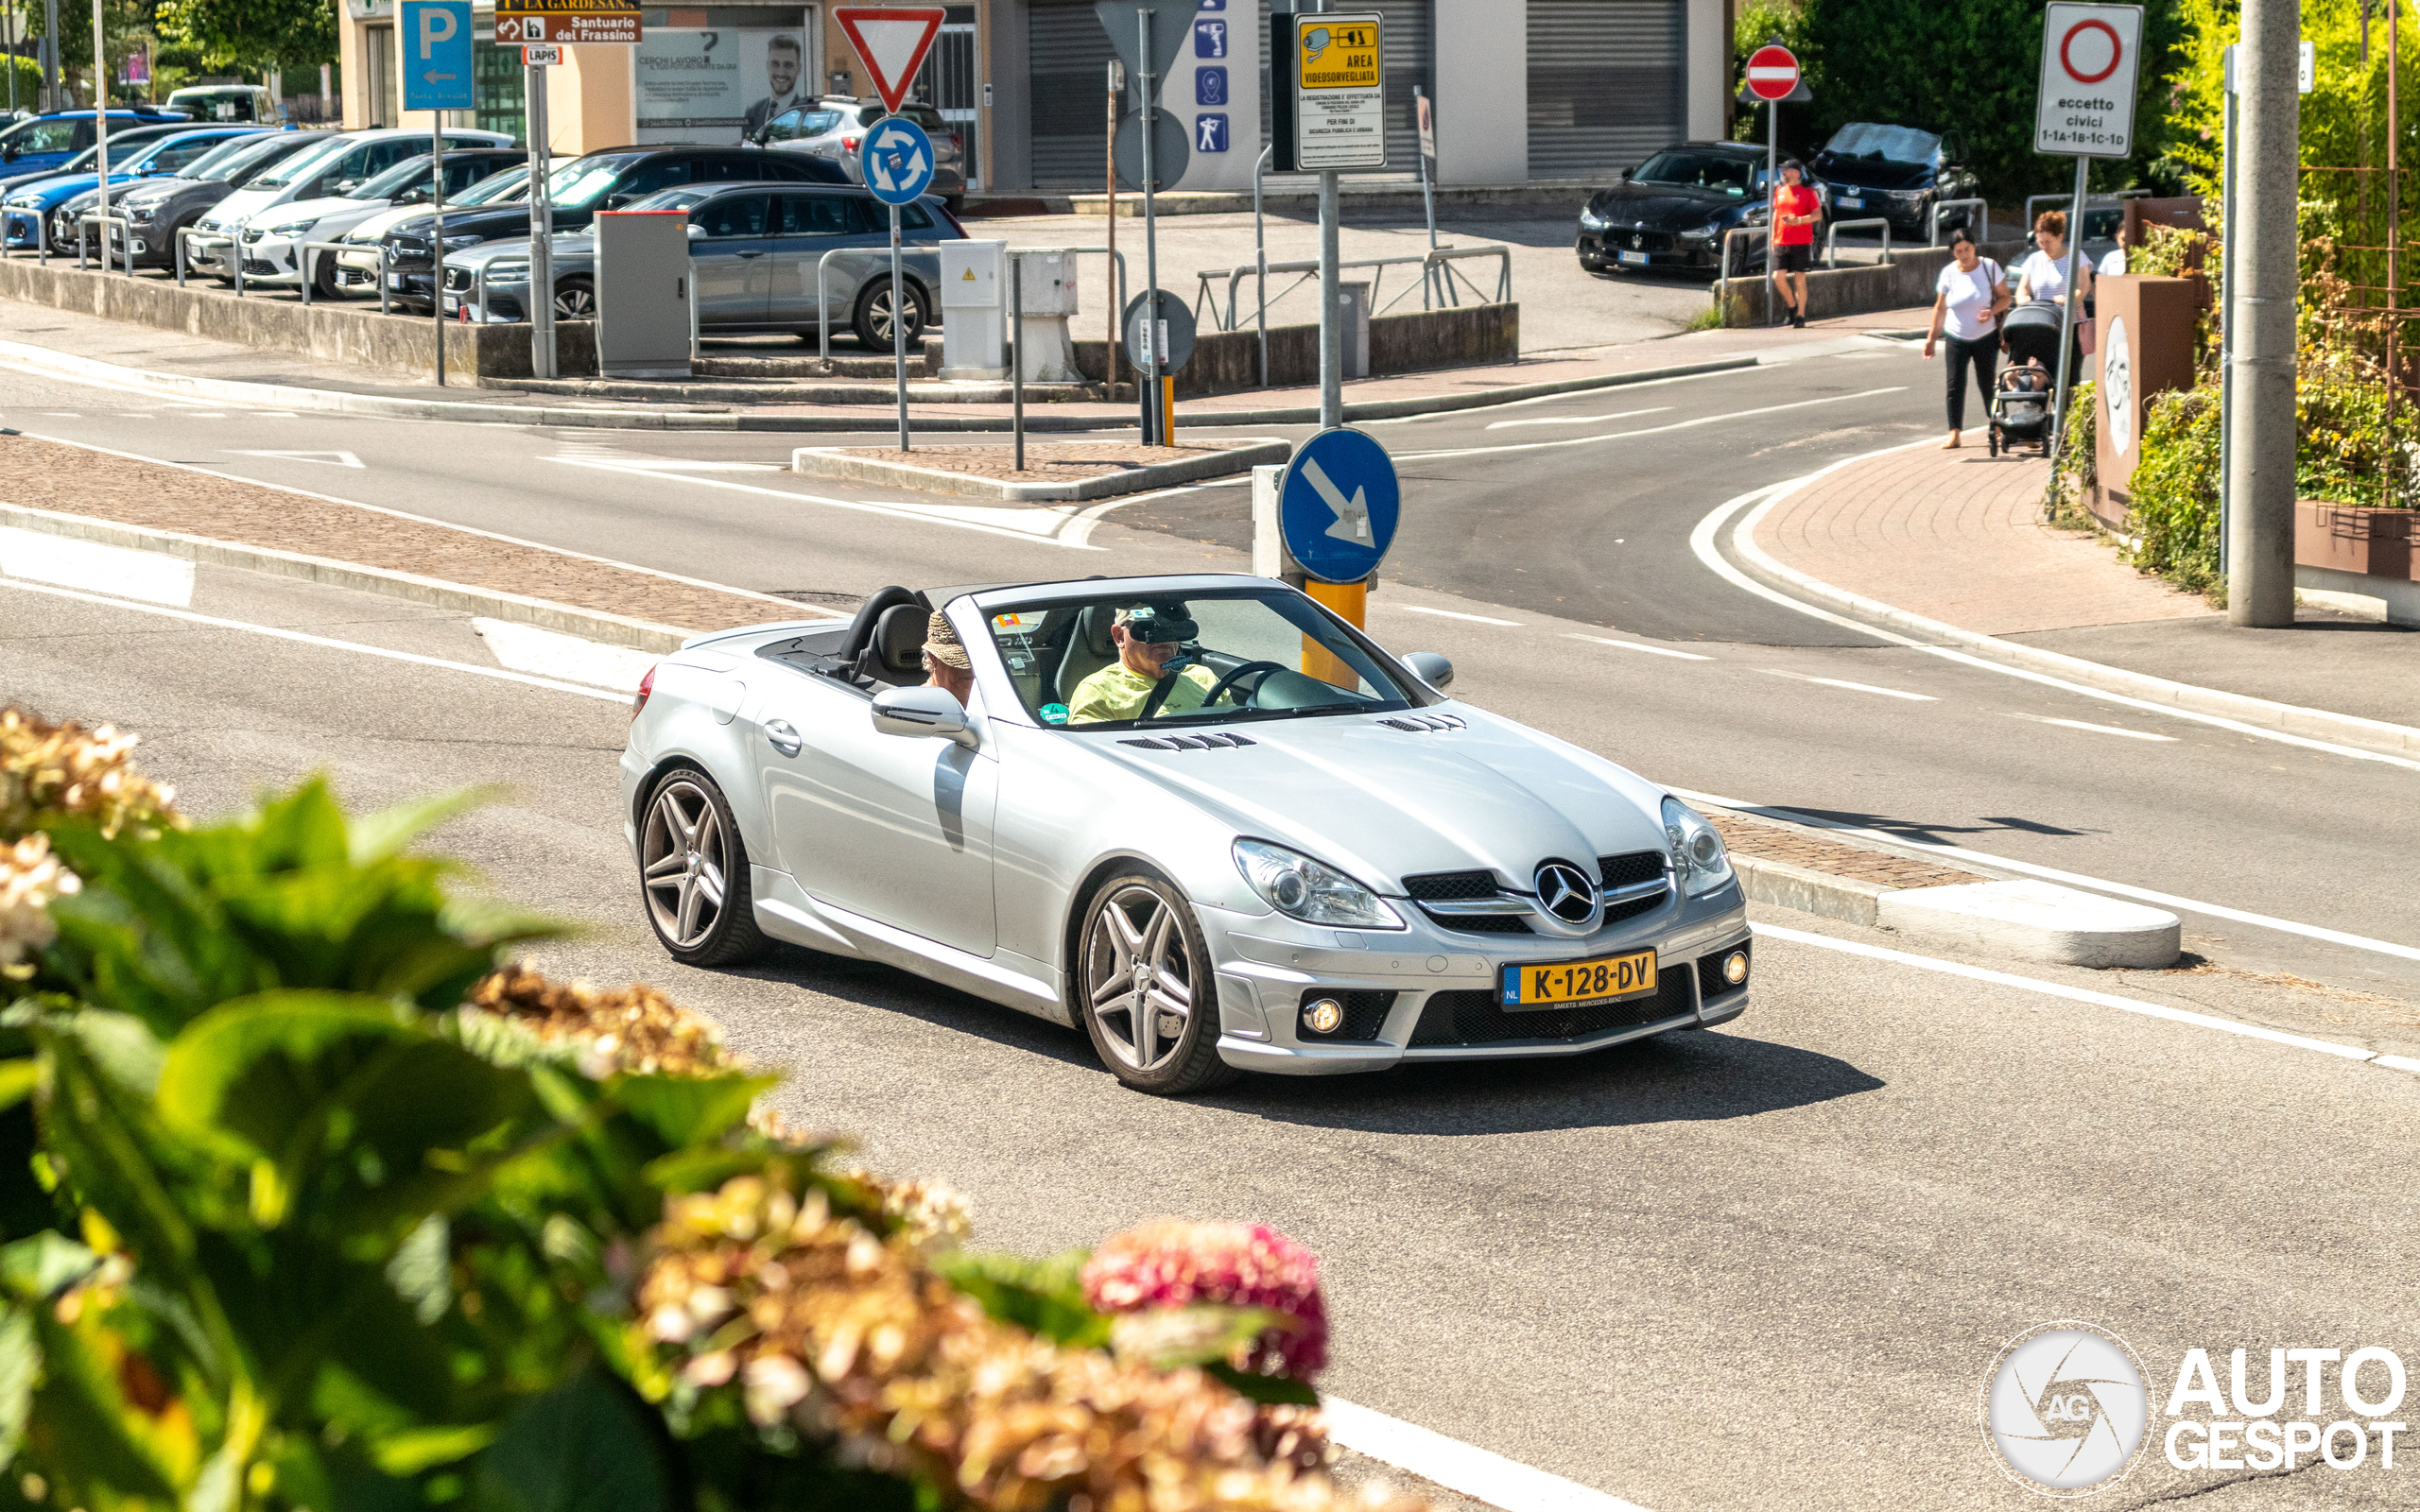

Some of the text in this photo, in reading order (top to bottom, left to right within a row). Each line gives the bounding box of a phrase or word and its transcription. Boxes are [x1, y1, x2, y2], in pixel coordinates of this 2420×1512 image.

[524, 0, 544, 9] LA
[571, 16, 635, 28] Santuario
[419, 8, 458, 60] P
[556, 30, 635, 41] del Frassino
[529, 50, 557, 60] LAPIS
[638, 57, 668, 65] CERCHI
[1346, 55, 1374, 68] AREA
[1305, 70, 1375, 83] VIDEOSORVEGLIATA
[2058, 97, 2115, 111] eccetto
[2066, 115, 2103, 128] civici
[2042, 129, 2125, 146] 1-1A-1B-1C-1D
[1534, 956, 1648, 999] K-128-DV
[1506, 990, 1518, 1000] NL
[1553, 995, 1622, 1010] SMEETS MERCEDES-BENZ
